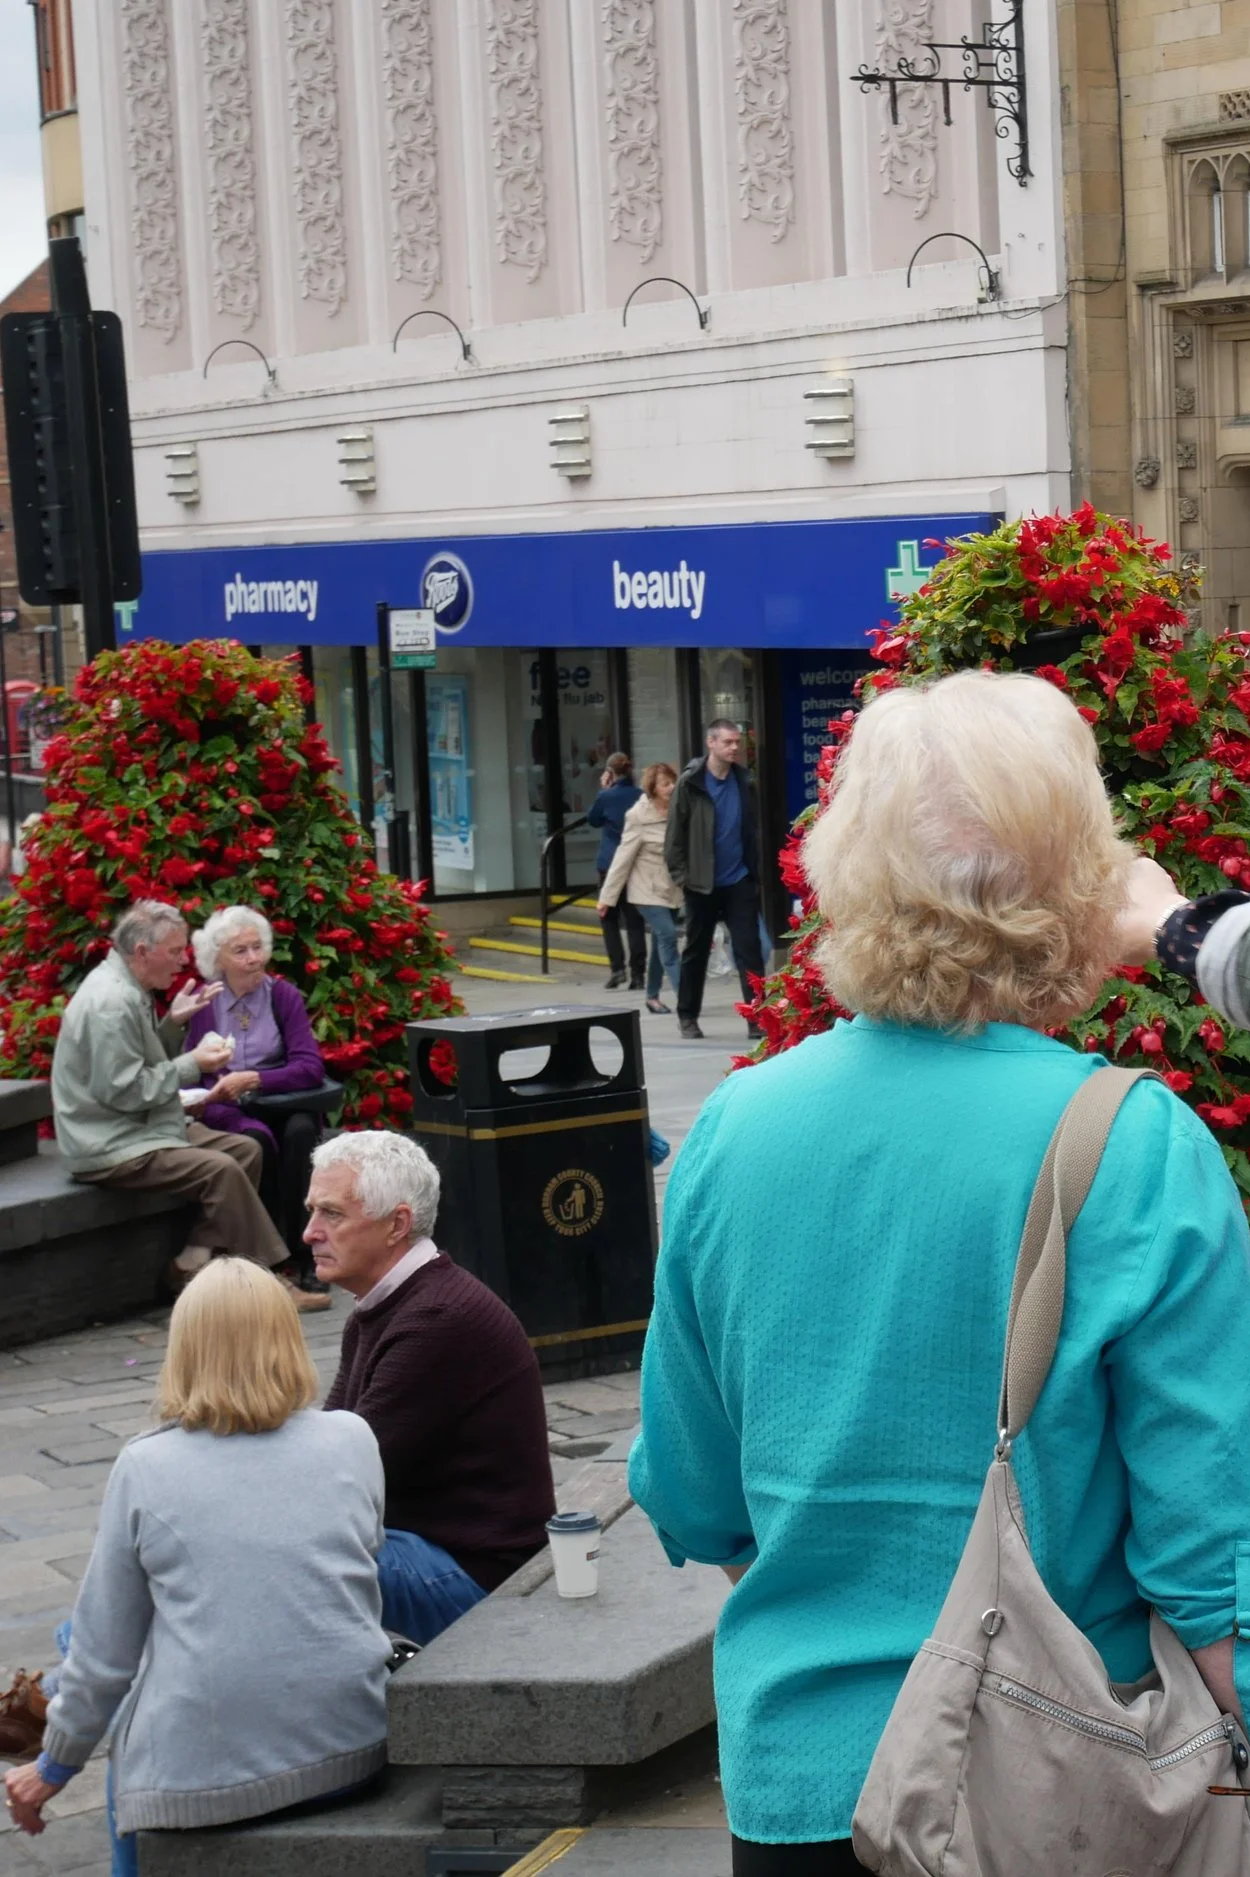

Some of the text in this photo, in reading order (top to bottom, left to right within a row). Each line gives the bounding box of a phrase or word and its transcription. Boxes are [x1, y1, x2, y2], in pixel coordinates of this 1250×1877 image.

[224, 572, 318, 622] pharmacy
[613, 559, 705, 620] beauty
[529, 661, 591, 690] fee
[802, 732, 834, 745] food
